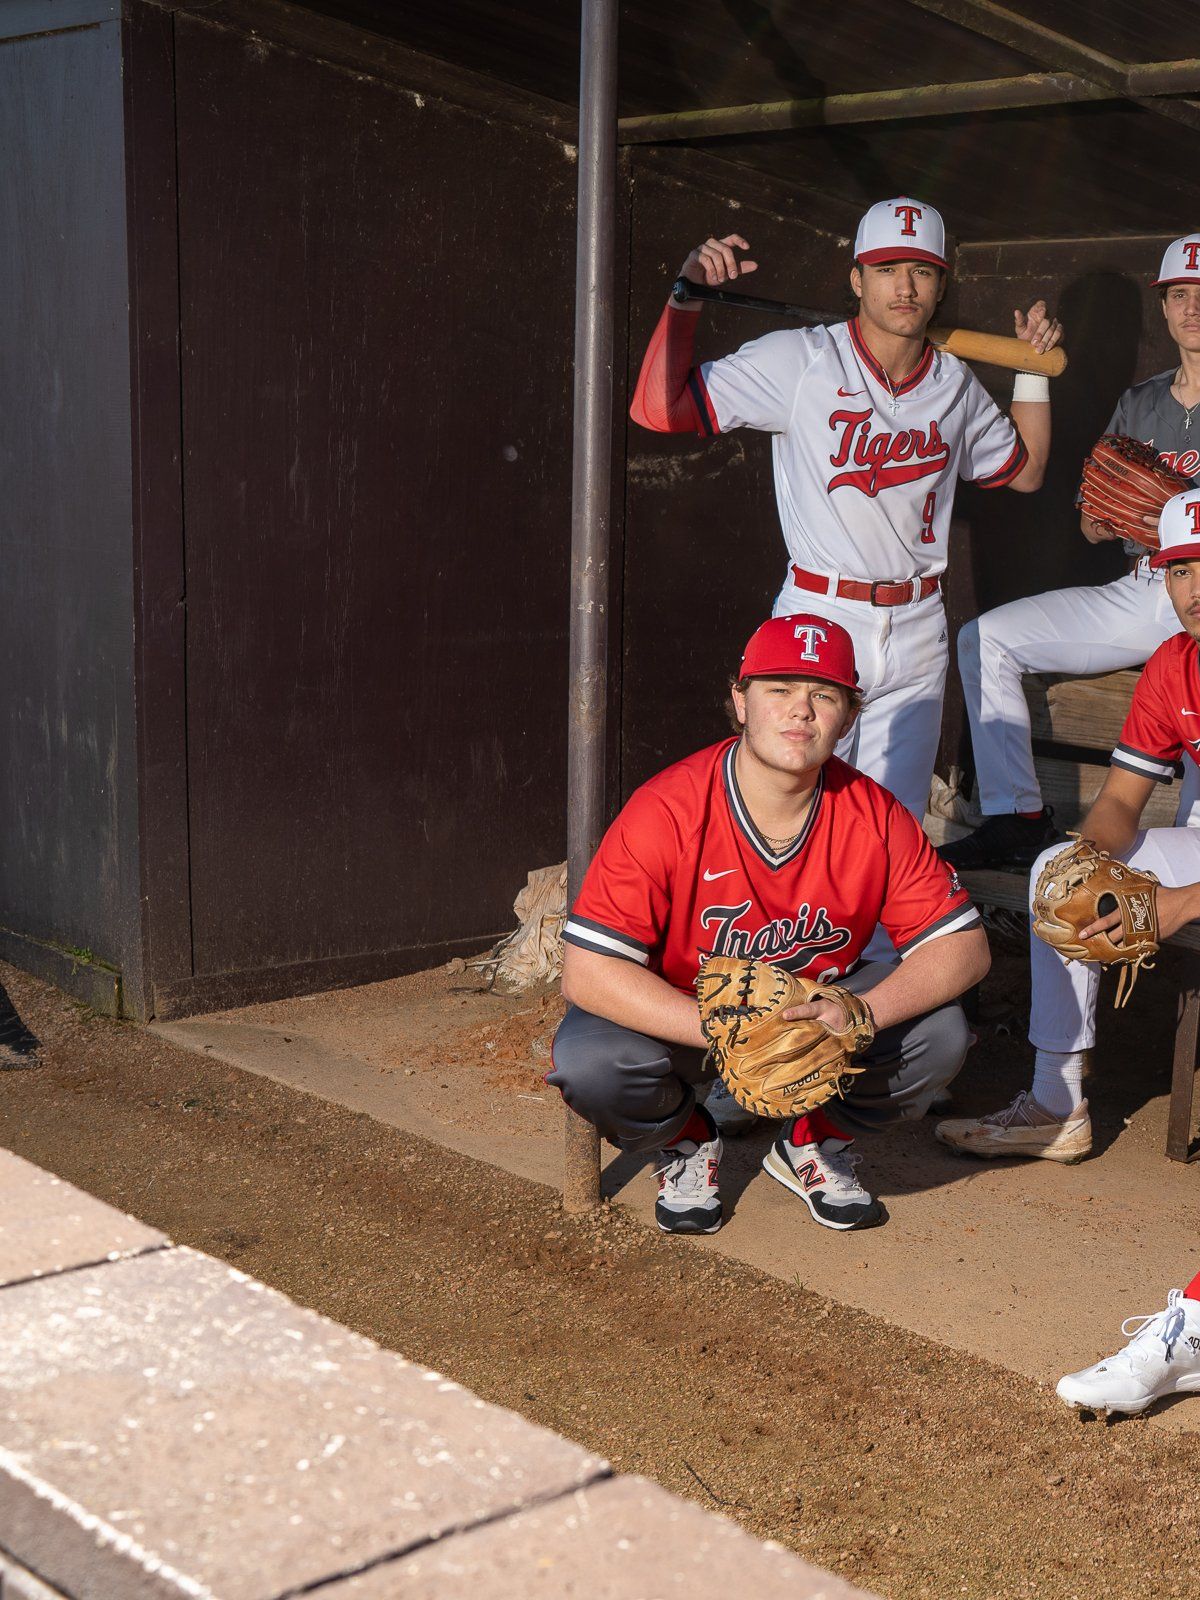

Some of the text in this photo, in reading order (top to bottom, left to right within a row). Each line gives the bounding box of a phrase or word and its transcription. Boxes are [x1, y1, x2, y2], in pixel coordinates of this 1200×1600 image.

[894, 205, 923, 237] T
[828, 407, 951, 498] Tigers
[920, 491, 937, 544] 9
[793, 624, 828, 663] T
[700, 899, 852, 972] Travis
[782, 1071, 820, 1097] A2000
